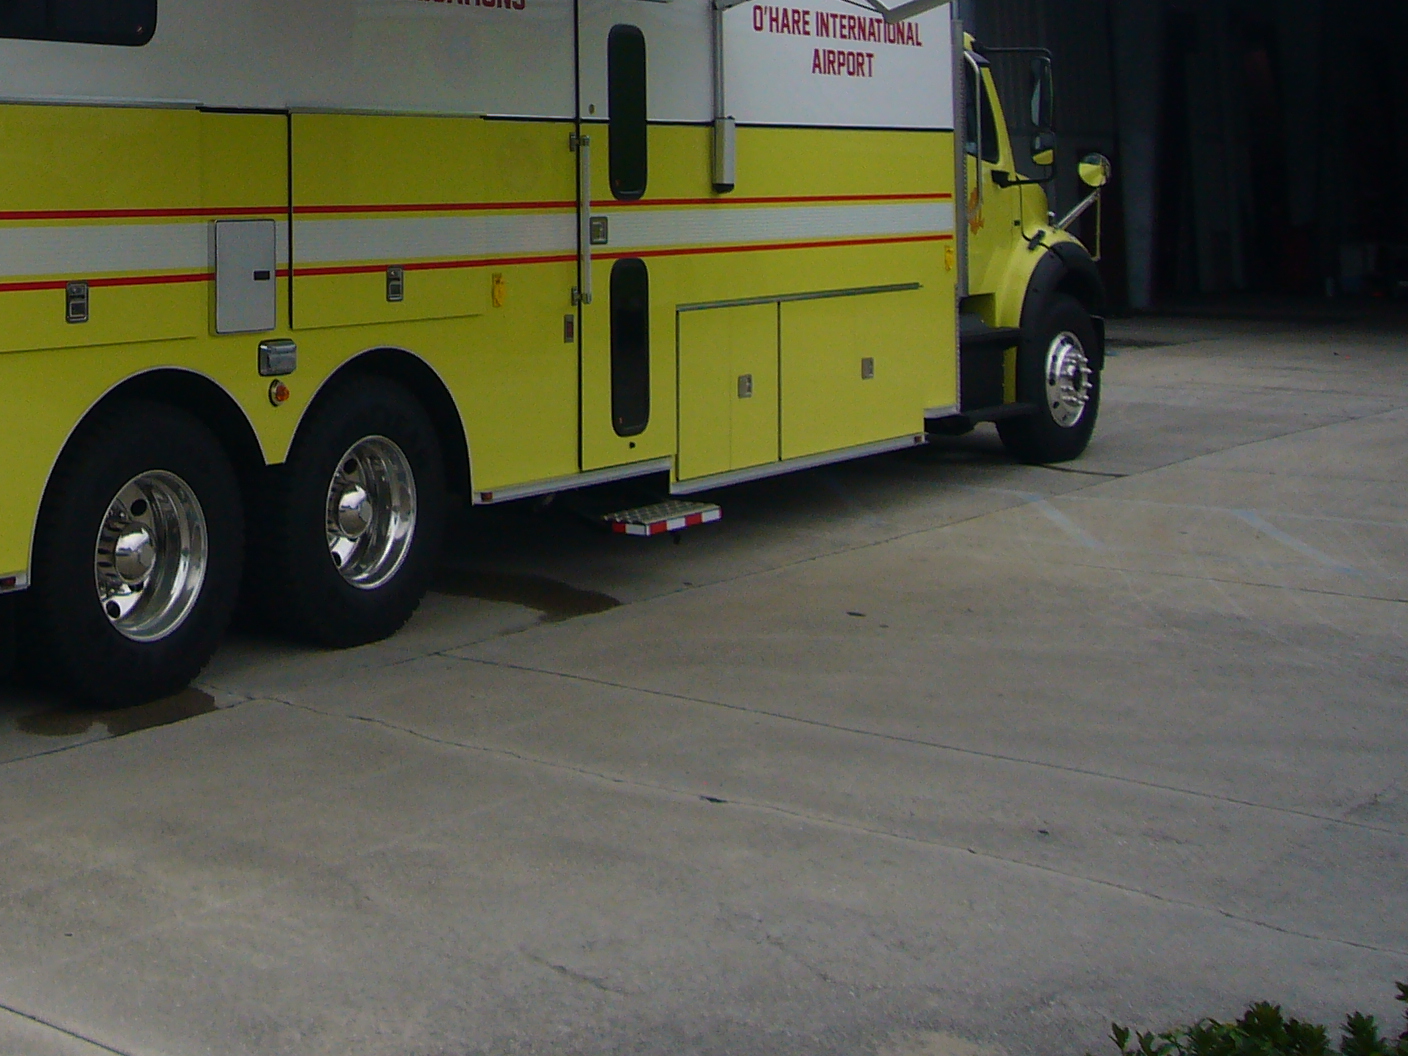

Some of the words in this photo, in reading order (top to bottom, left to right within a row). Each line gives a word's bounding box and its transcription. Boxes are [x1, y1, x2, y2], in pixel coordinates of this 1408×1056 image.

[752, 4, 811, 36] O'HARE
[815, 10, 924, 47] INTERNATIONAL
[811, 48, 875, 78] AIRPORT
